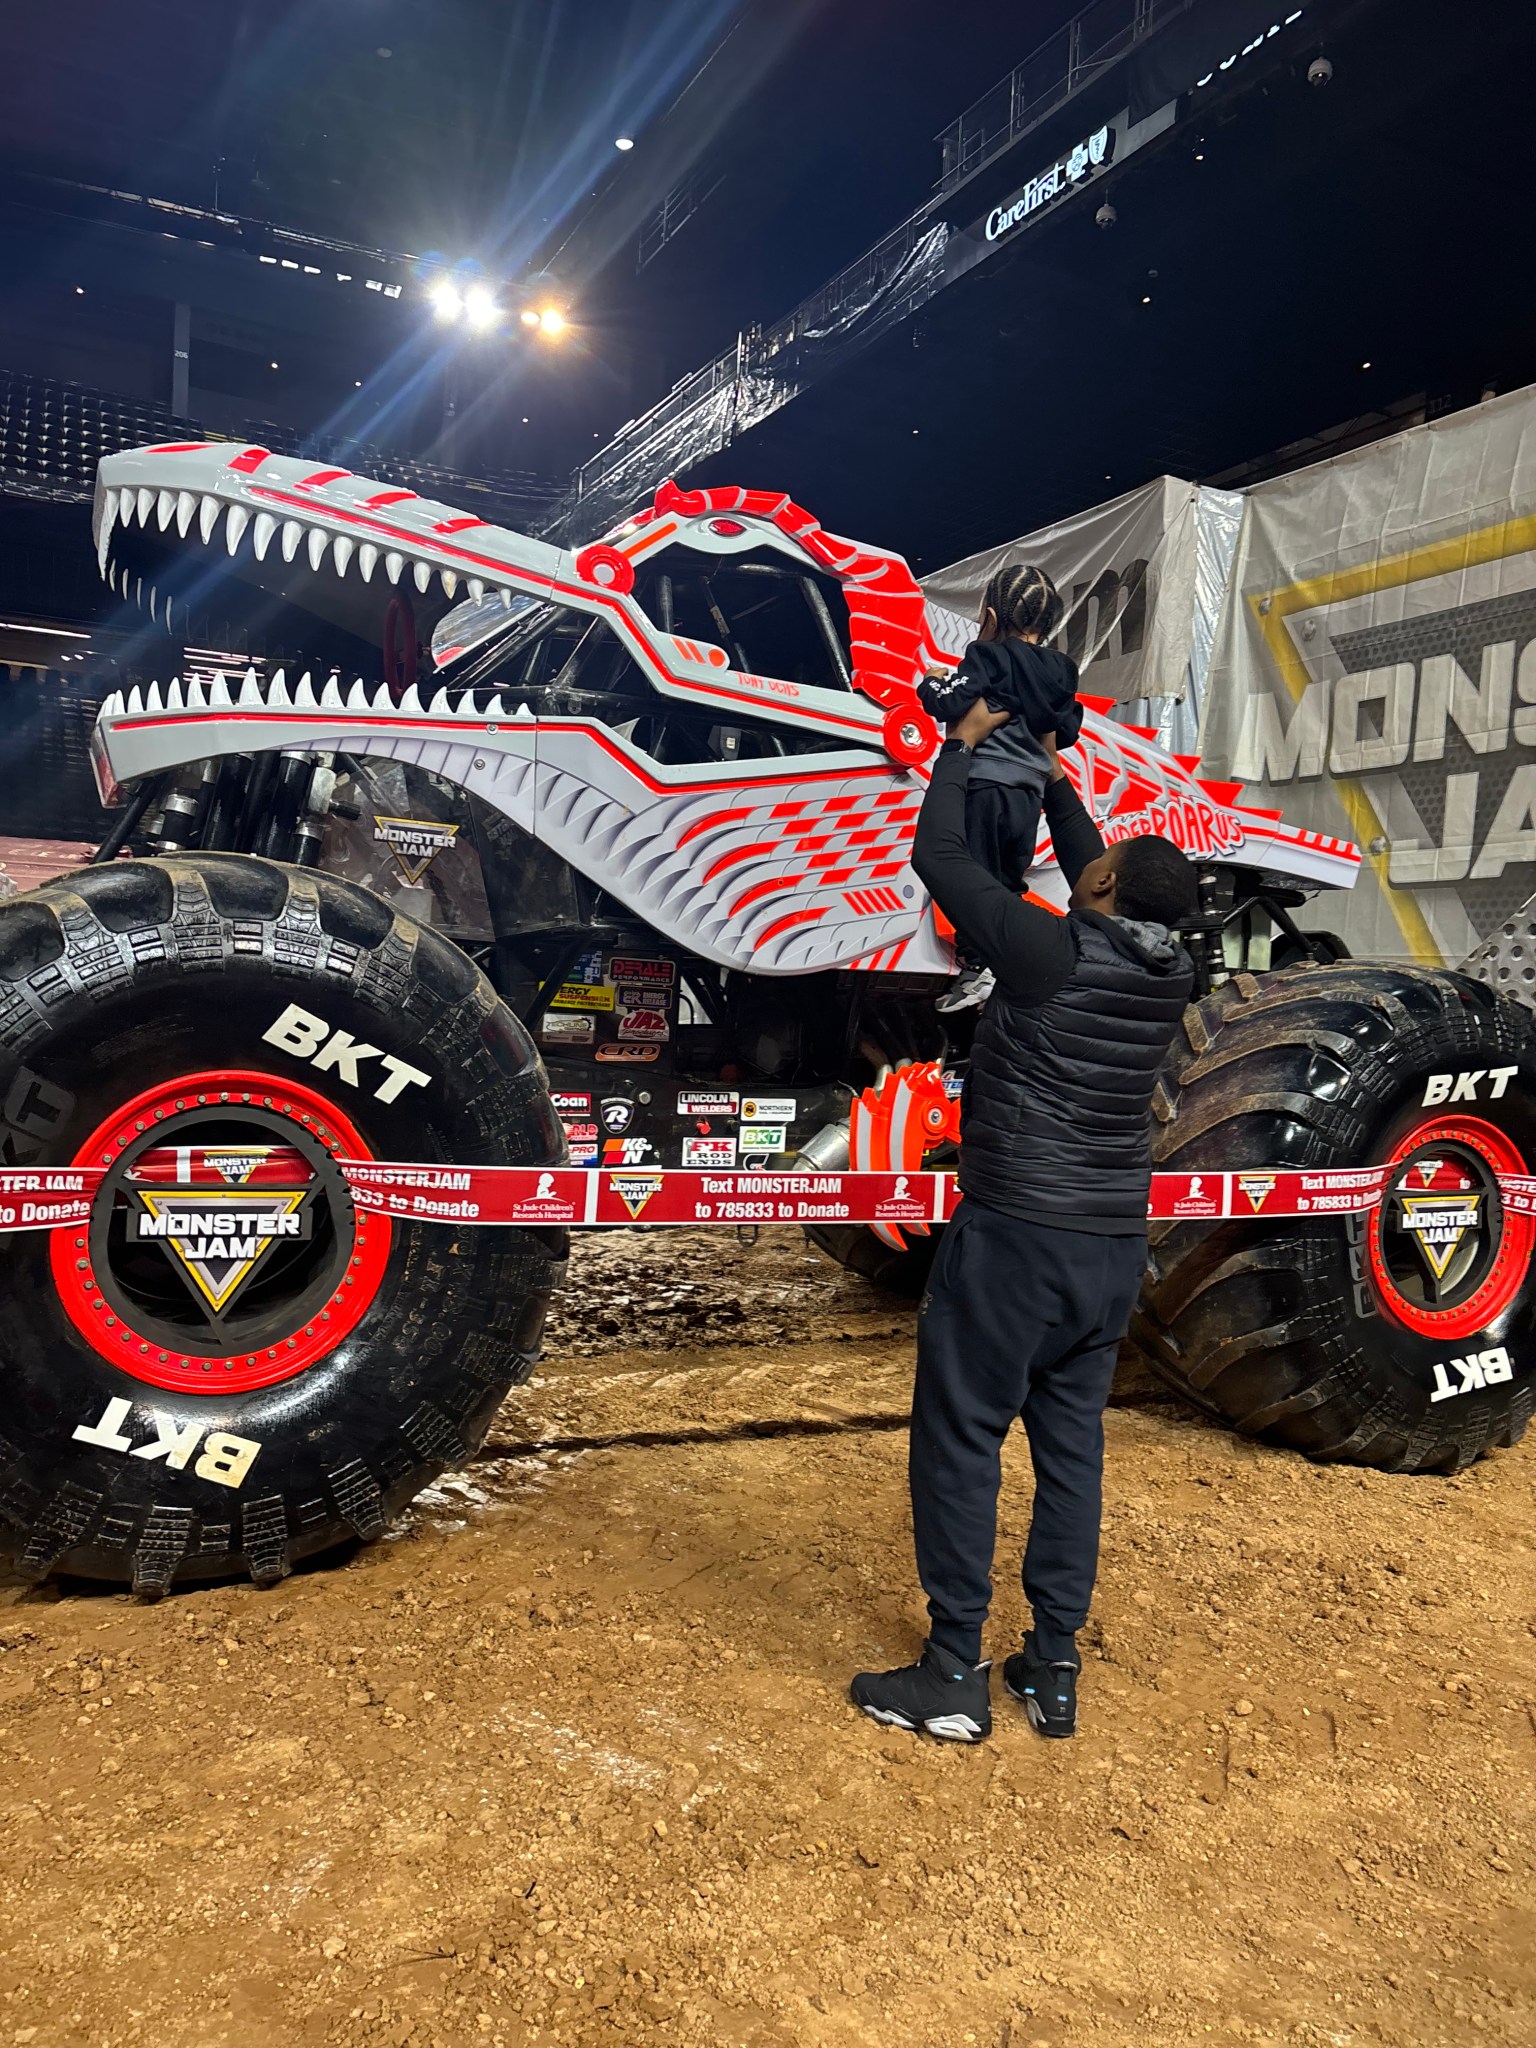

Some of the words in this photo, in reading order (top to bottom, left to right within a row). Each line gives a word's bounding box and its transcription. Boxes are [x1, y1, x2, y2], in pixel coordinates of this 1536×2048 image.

[174, 350, 189, 359] 206
[374, 828, 456, 848] MONSTER
[397, 844, 433, 857] JAM
[612, 960, 671, 977] DERALE
[612, 974, 671, 983] PERFORMANCE
[623, 1011, 666, 1030] JAZ
[261, 1002, 432, 1105] BKT
[1421, 1066, 1519, 1108] BKT
[551, 1093, 588, 1107] Coan
[681, 1093, 728, 1104] LINCOLN
[691, 1104, 733, 1113] WELDERS
[743, 1130, 782, 1144] BKT
[690, 1141, 732, 1152] FK
[203, 1157, 267, 1168] MONSTER
[220, 1165, 252, 1175] JAM
[609, 1182, 662, 1192] MONSTER
[701, 1177, 734, 1193] Text
[737, 1177, 842, 1194] MONSTERJAM
[1301, 1176, 1324, 1190] Text
[623, 1191, 648, 1200] JAM
[1297, 1197, 1310, 1211] to
[1311, 1195, 1352, 1210] 785833
[21, 1199, 91, 1222] Donate
[389, 1193, 408, 1210] to
[413, 1195, 480, 1218] Donate
[523, 1203, 539, 1212] Jude
[695, 1202, 712, 1218] to
[716, 1202, 774, 1218] 785833
[778, 1202, 794, 1218] to
[797, 1202, 850, 1218] Donate
[544, 1212, 574, 1220] Hospital
[1402, 1210, 1478, 1229] MONSTER
[139, 1213, 300, 1236] MONSTER
[1423, 1227, 1460, 1243] JAM
[184, 1236, 255, 1259] JAM
[1431, 1347, 1514, 1403] BKT
[71, 1396, 262, 1489] BKT
